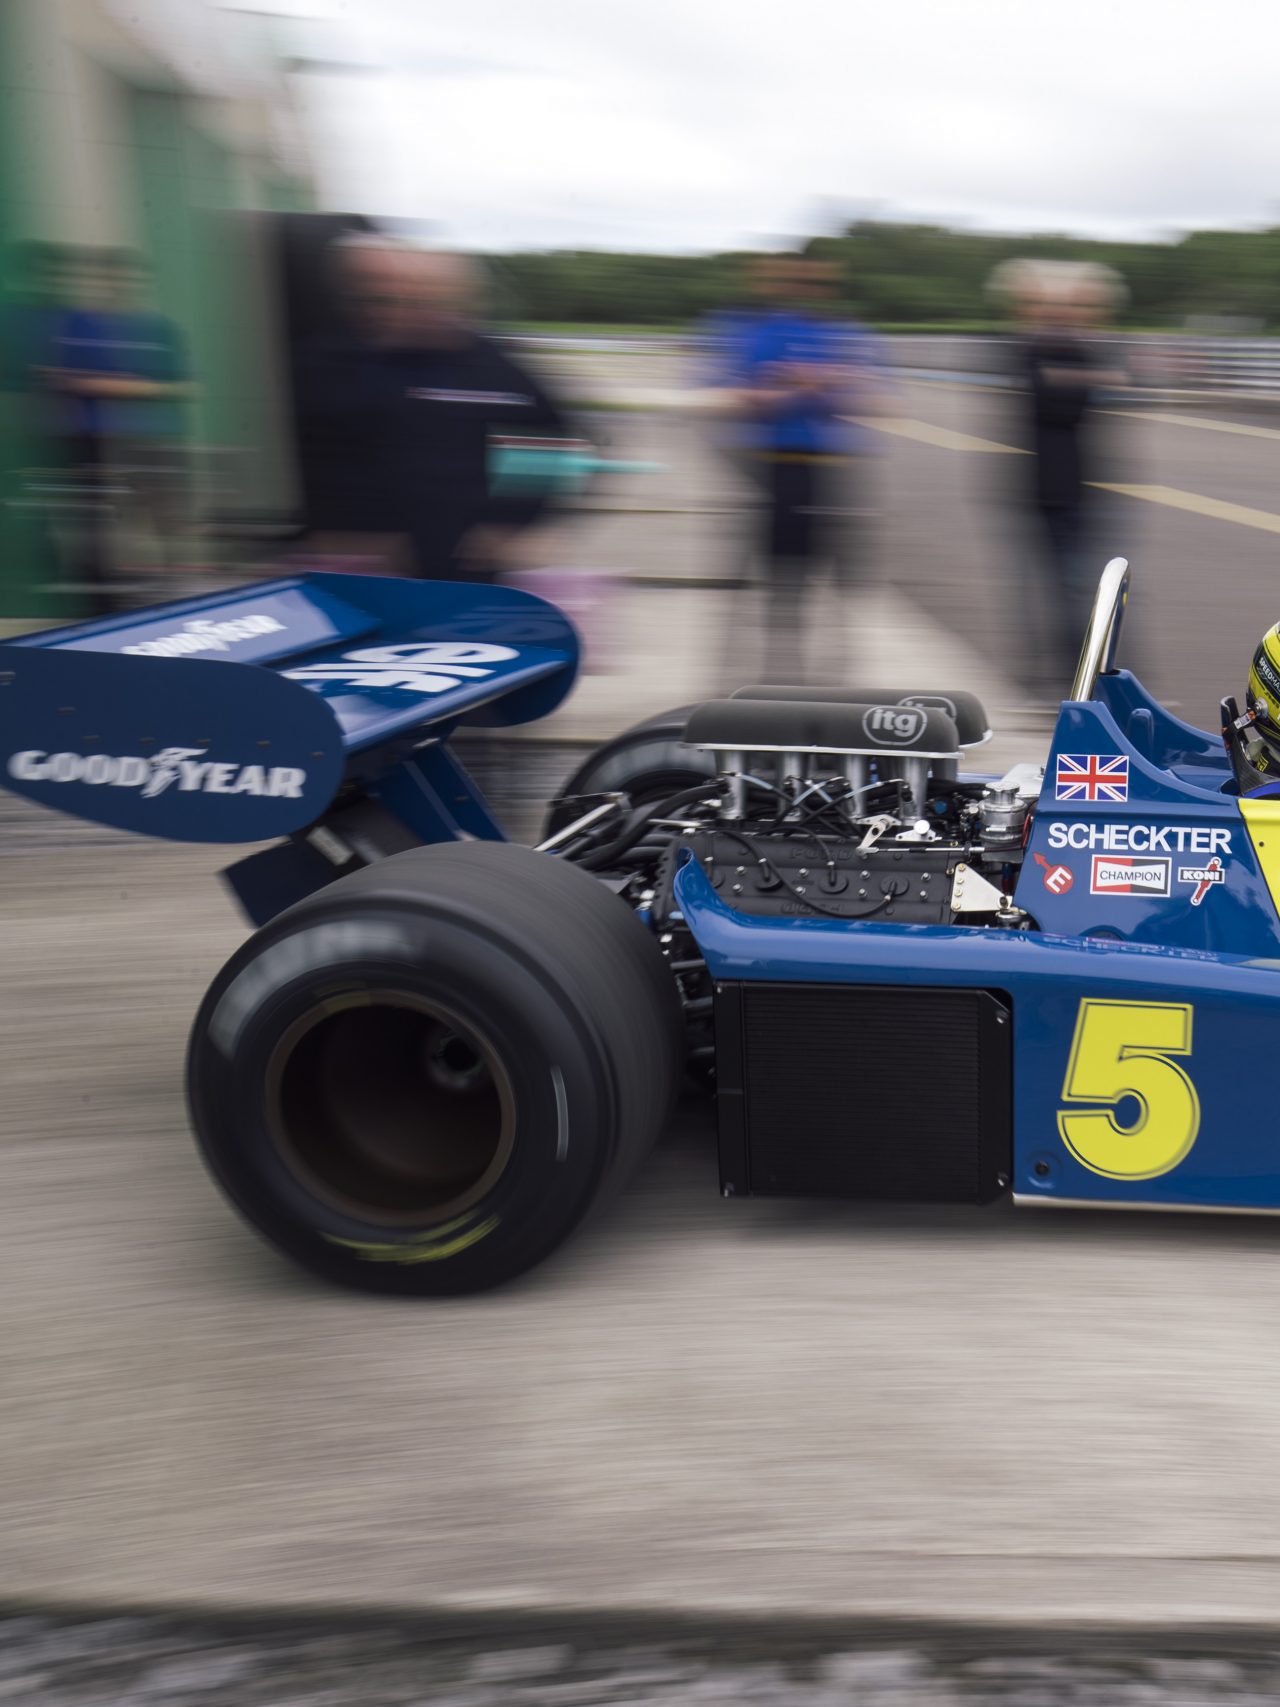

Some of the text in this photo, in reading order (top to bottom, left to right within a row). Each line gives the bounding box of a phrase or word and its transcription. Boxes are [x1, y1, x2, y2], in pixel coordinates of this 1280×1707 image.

[872, 708, 918, 737] itg
[8, 746, 307, 799] GOODYEAR
[1047, 822, 1232, 854] SCHECKTER
[1099, 870, 1162, 882] CHAMPION
[1182, 871, 1220, 882] KONI
[1056, 997, 1201, 1182] 5
